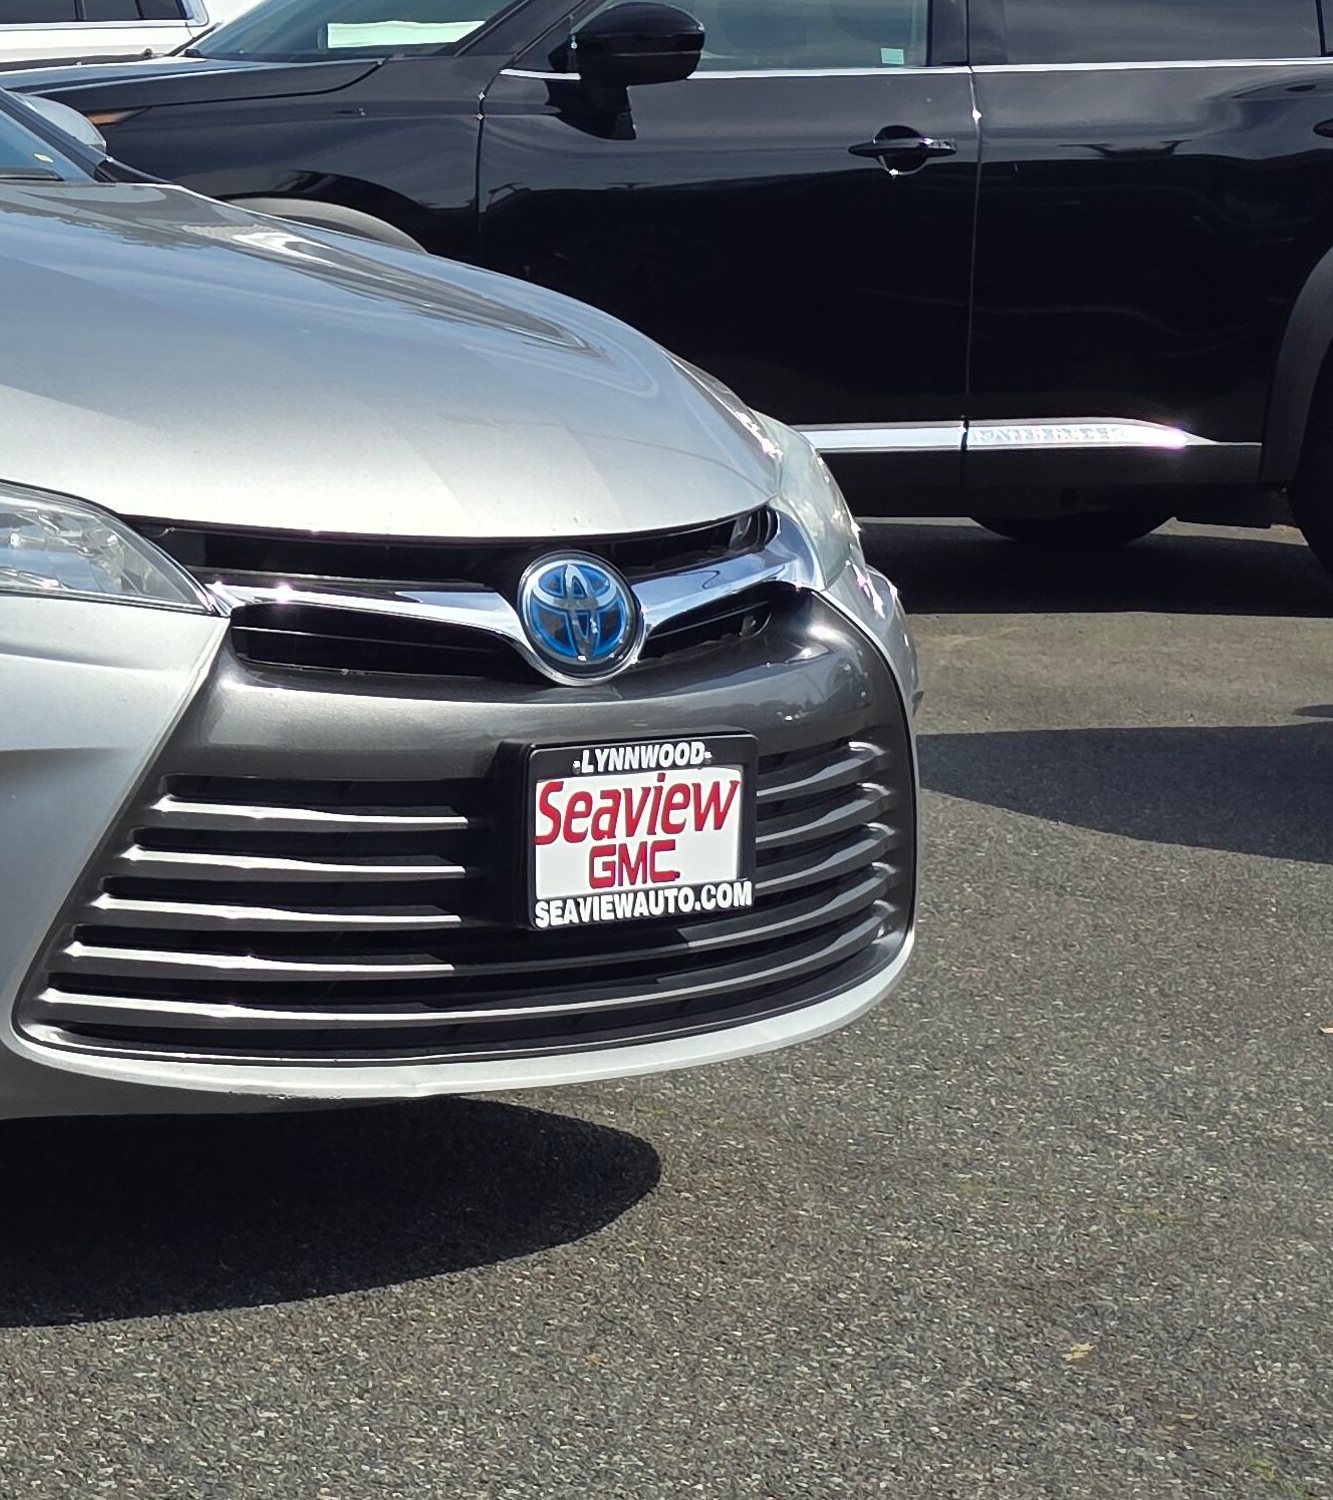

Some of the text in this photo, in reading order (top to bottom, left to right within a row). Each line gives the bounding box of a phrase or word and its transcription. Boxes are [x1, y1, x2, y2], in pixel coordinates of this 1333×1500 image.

[581, 741, 705, 773] LYNNWOOD
[533, 772, 740, 845] Seaview
[589, 839, 678, 889] GMC
[535, 881, 752, 928] SEAVIEWAUTO.COM
